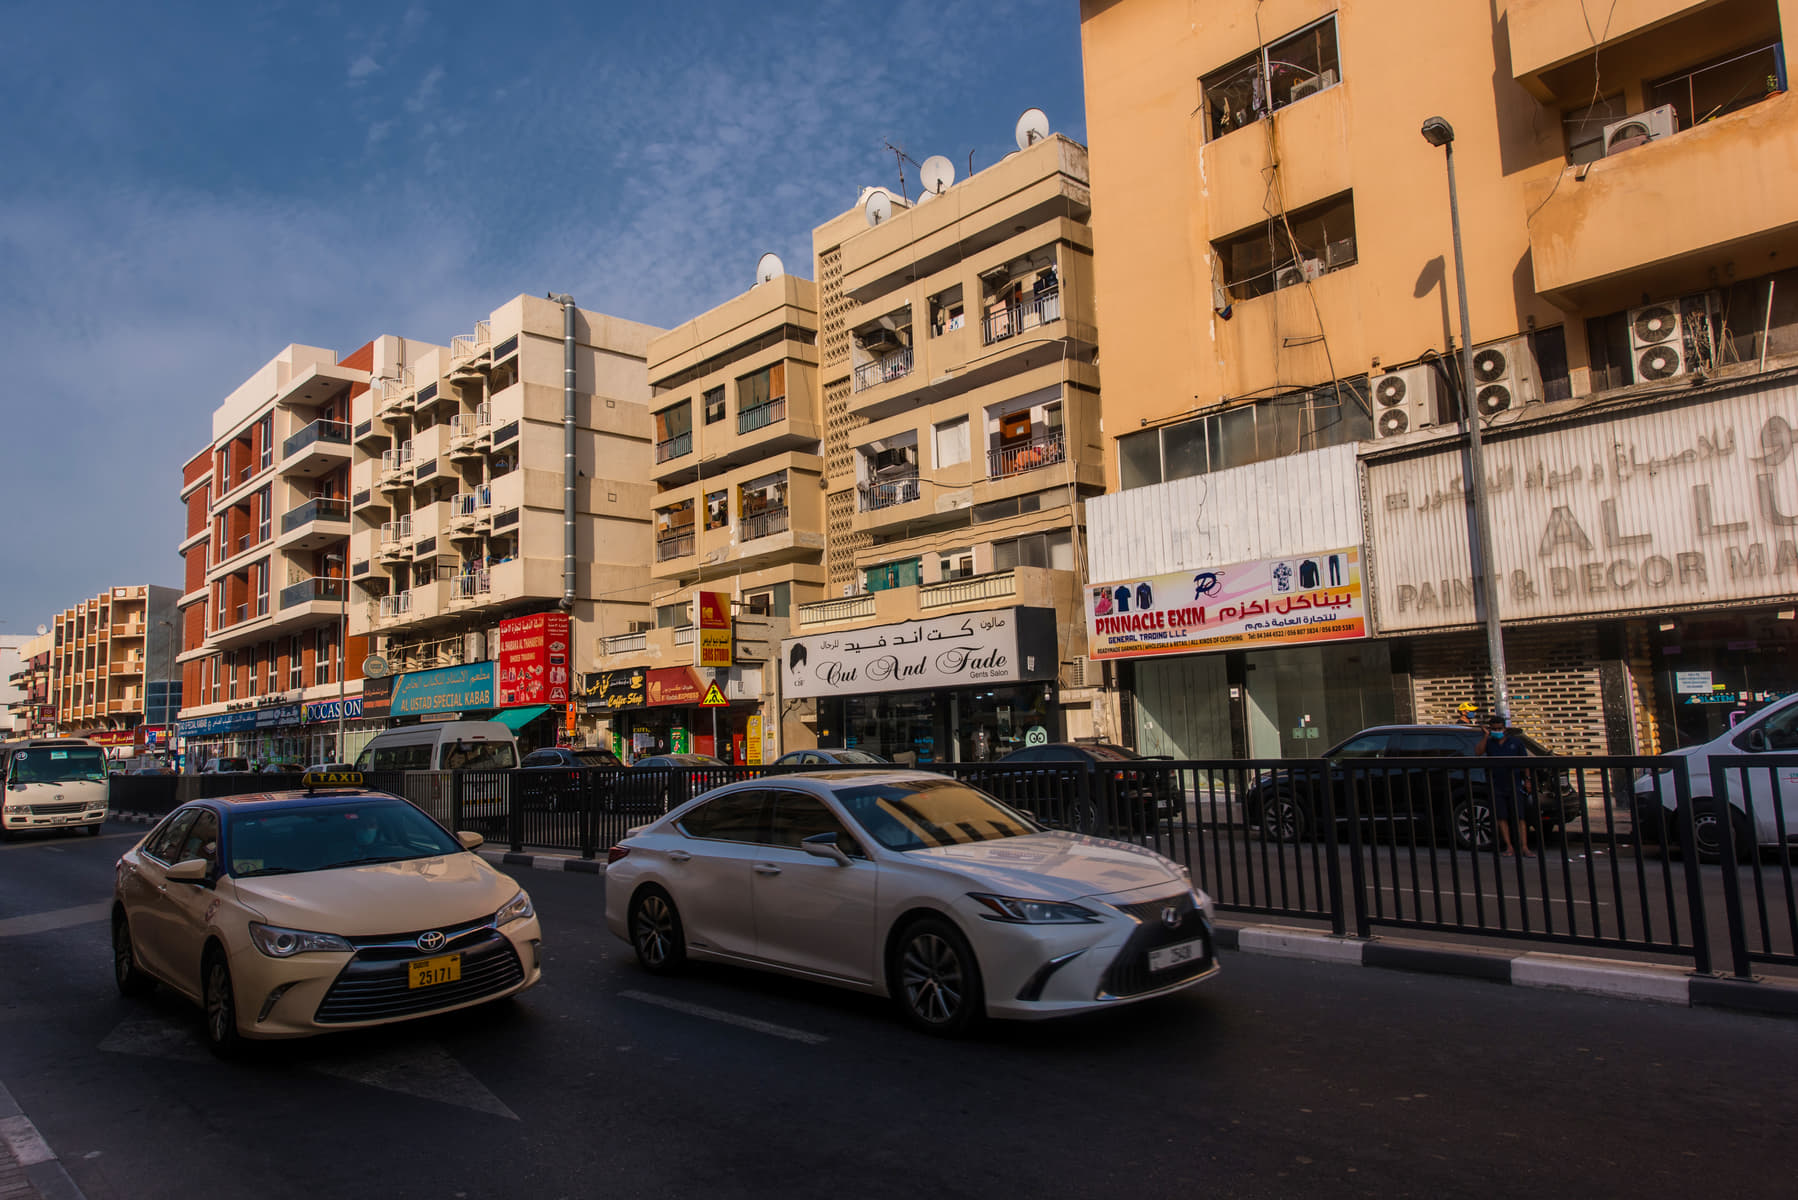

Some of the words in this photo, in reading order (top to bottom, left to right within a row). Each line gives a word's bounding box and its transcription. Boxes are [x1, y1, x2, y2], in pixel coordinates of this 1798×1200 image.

[1539, 498, 1653, 557] AL
[1511, 569, 1539, 600] &
[1549, 551, 1708, 598] DECOR
[1219, 599, 1270, 621] اكزم
[1276, 591, 1353, 615] بيناكل
[980, 617, 1006, 631] صالون
[1095, 610, 1167, 636] PINNACLE
[1168, 606, 1206, 627] EXIM
[1271, 617, 1303, 628] العامة
[1303, 613, 1338, 625] للتجارة
[893, 626, 923, 646] اند
[927, 618, 975, 641] كت
[1108, 632, 1138, 645] GENERAL
[1139, 630, 1168, 642] TRADING
[844, 635, 887, 653] فيد
[1145, 643, 1169, 651] WHOLESALE
[1174, 641, 1188, 649] RETAIL
[1220, 635, 1244, 644] CLOTHING
[714, 648, 729, 661] STUDIO
[815, 661, 858, 689] Cut
[865, 654, 927, 681] And
[935, 645, 1007, 675] Fade
[970, 670, 988, 680] Gents
[990, 668, 1009, 678] Salon
[401, 698, 409, 713] AL
[410, 695, 432, 711] USTAD
[433, 692, 463, 709] SPECIAL
[464, 689, 490, 706] KABAB
[608, 693, 627, 708] Coffee
[627, 692, 644, 706] Shop
[307, 699, 362, 721] OCCASON
[317, 773, 356, 783] TAXI
[419, 967, 451, 985] 25171
